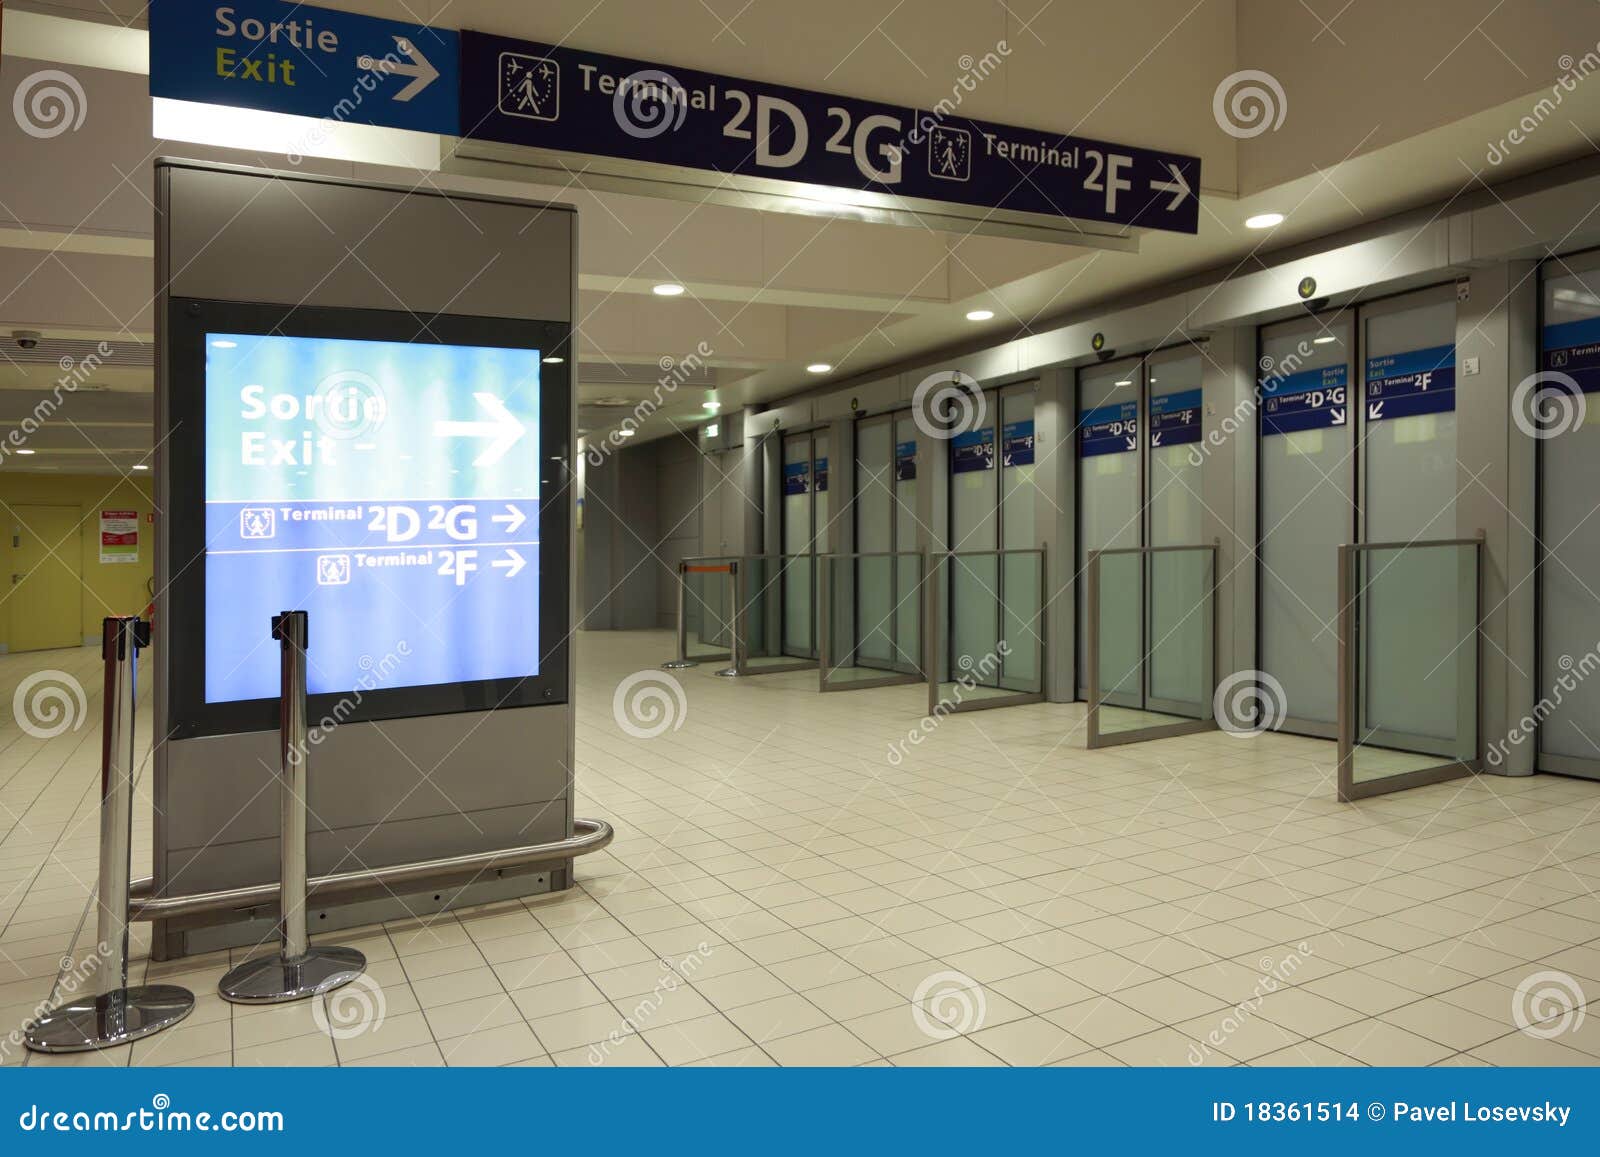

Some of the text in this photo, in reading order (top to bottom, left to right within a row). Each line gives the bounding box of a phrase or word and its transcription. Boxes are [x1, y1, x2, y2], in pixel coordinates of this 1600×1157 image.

[215, 7, 339, 53] Sortie
[216, 47, 296, 86] Exit
[578, 64, 902, 184] Terminal 2D 2G
[984, 133, 1133, 214] Terminal 2F
[1305, 391, 1324, 408] 2D
[1326, 387, 1345, 404] 2G
[1384, 372, 1432, 391] Terminal 2F
[240, 384, 387, 422] Sortie
[241, 431, 338, 466] Exit
[280, 504, 477, 543] Terminal 2D 2G
[355, 550, 477, 586] Terminal 2F
